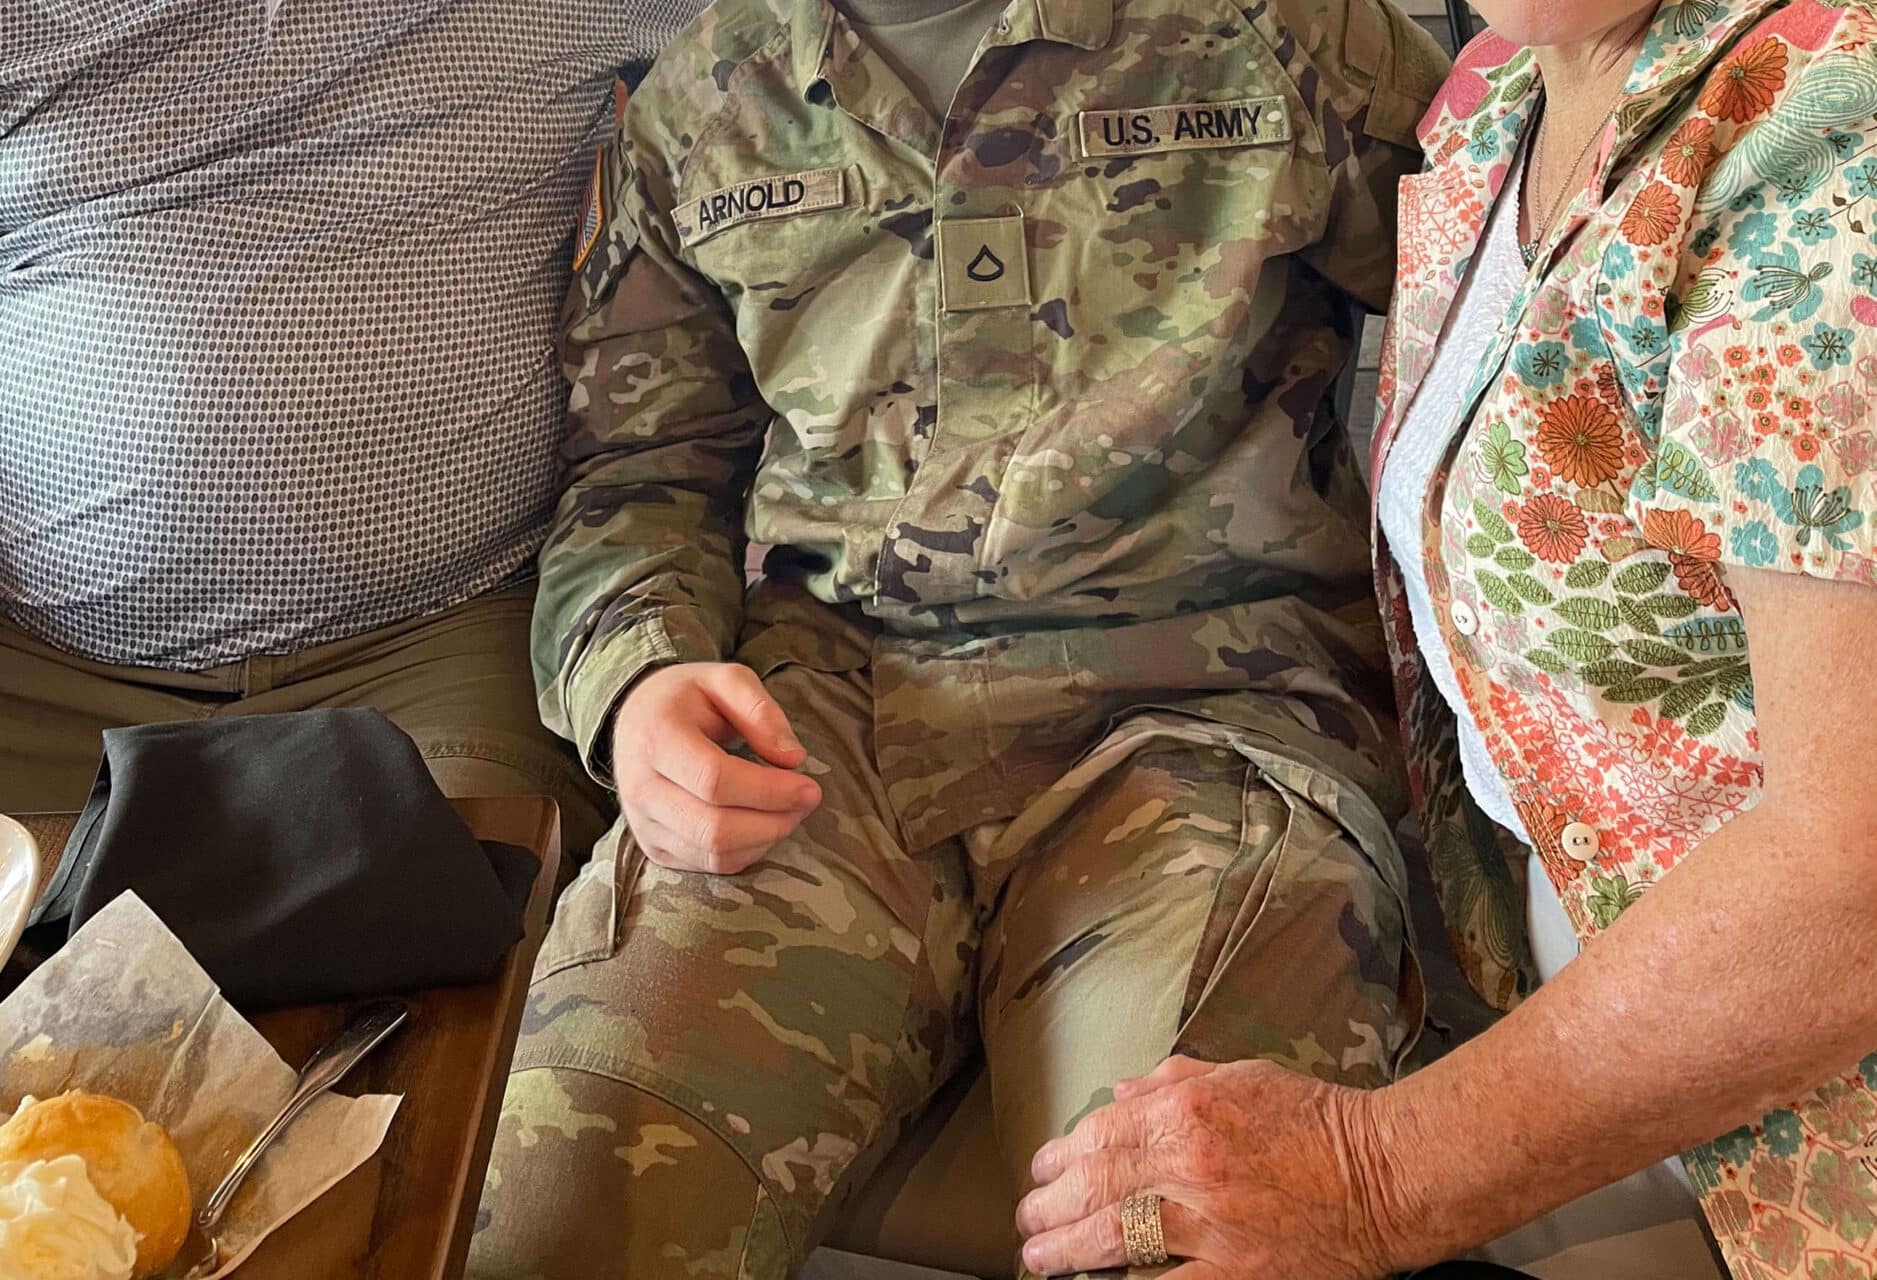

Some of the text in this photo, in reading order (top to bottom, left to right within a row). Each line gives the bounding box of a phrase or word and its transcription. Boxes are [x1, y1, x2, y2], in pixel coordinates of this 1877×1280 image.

[1103, 105, 1262, 147] U.S. ARMY
[699, 179, 806, 231] ARNOLD
